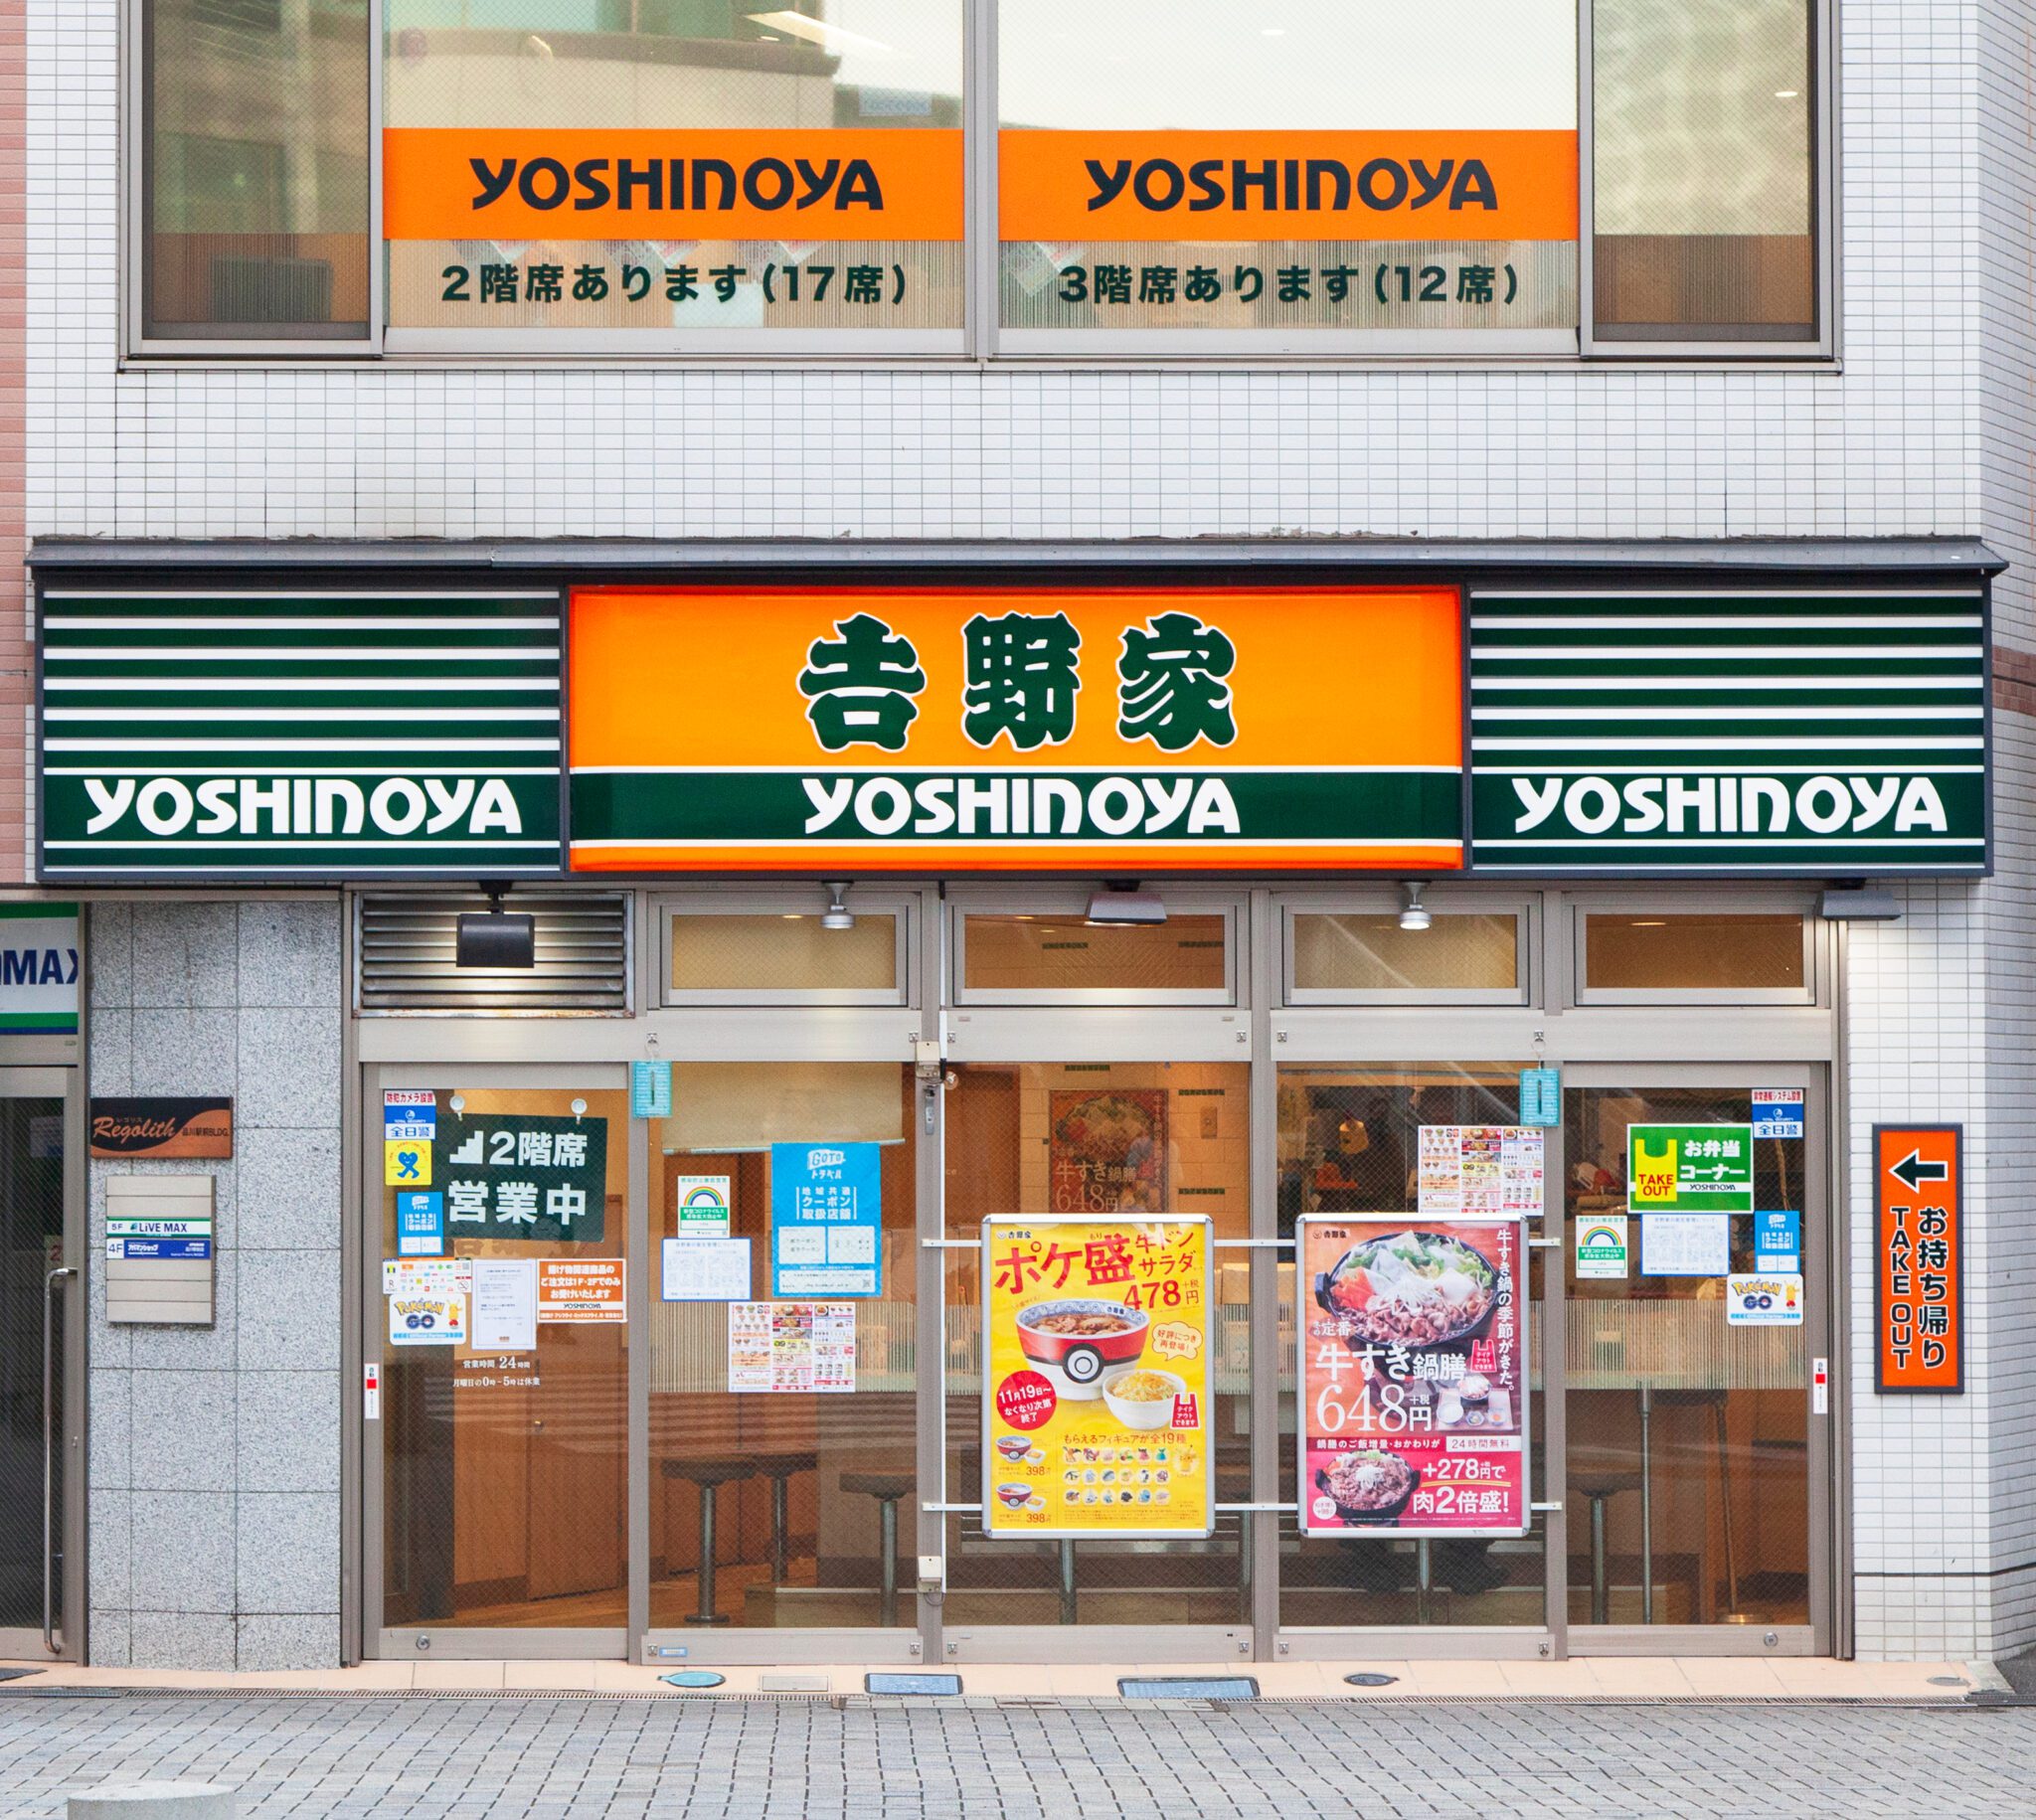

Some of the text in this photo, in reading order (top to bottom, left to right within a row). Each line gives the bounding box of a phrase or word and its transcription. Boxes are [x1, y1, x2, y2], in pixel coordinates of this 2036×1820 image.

[469, 157, 884, 211] YOSHINOYA
[1084, 157, 1498, 212] YOSHINOYA
[795, 610, 1239, 753] 吉野家
[84, 777, 522, 836] YOSHINOYA
[802, 775, 1241, 836] YOSHINOYA
[1511, 775, 1949, 836] YOSHINOYA
[92, 1116, 176, 1144] Regolith
[489, 1130, 588, 1167] 2階席
[1685, 1139, 1741, 1157] お弁当
[1638, 1174, 1674, 1185] TAKE
[1680, 1163, 1746, 1181] コーナー
[802, 1196, 851, 1208] クーポン
[1642, 1186, 1670, 1196] OUT
[448, 1180, 587, 1226] 営業中
[164, 1223, 188, 1233] MAX
[108, 1243, 123, 1252] 4F
[995, 1233, 1136, 1294] ポケ盛
[1138, 1249, 1197, 1277] サラダ
[1891, 1206, 1912, 1370] TAKE OUT
[1918, 1207, 1949, 1370] お持ち帰り
[1744, 1295, 1773, 1310] GO
[406, 1314, 435, 1329] GO
[1315, 1342, 1466, 1382] 牛すき鍋膳
[1004, 1399, 1053, 1416] なくなり次第
[1020, 1411, 1037, 1423] 終了
[1451, 1439, 1510, 1449] 24時間無料
[1026, 1465, 1045, 1476] 398
[1026, 1513, 1045, 1523] 398
